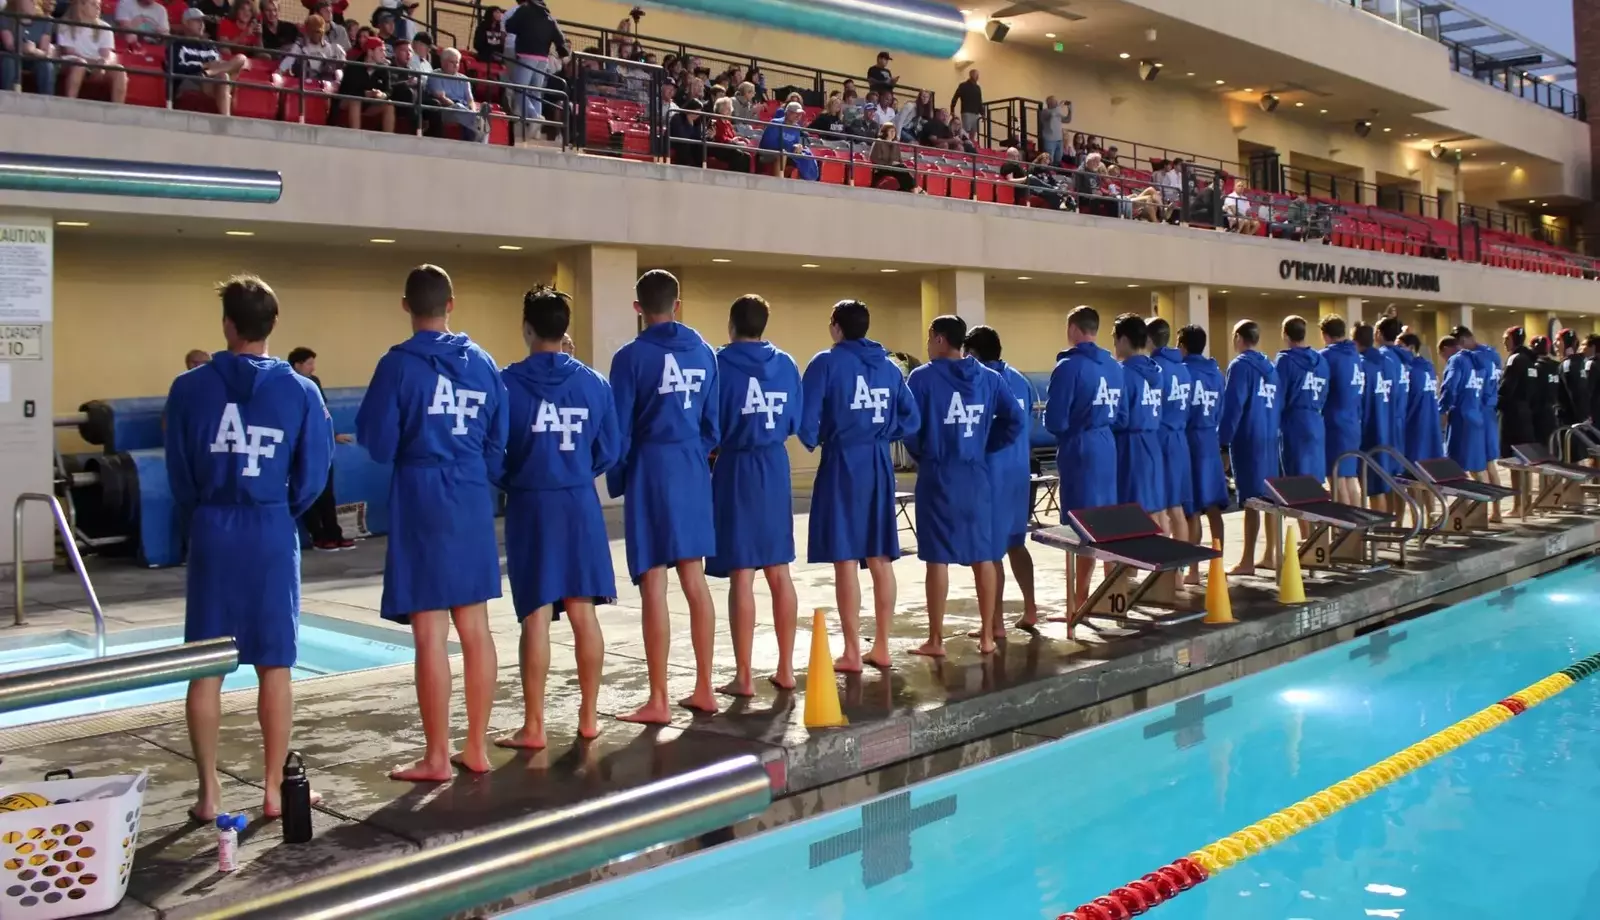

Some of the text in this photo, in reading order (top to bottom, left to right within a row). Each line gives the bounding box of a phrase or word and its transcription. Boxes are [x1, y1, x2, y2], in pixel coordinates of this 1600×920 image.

[0, 228, 46, 243] AUTION
[1339, 265, 1395, 288] AQUATICS
[8, 341, 24, 356] 10
[658, 353, 705, 409] AF
[1092, 376, 1121, 418] AF
[1141, 379, 1161, 416] AF
[1167, 374, 1190, 410] AF
[1191, 379, 1218, 416] AF
[1257, 376, 1276, 408] AF
[1302, 371, 1325, 400] AF
[1374, 371, 1392, 402] AF
[1465, 369, 1484, 397] AF
[428, 374, 486, 435] AF
[741, 377, 787, 429] AF
[850, 375, 890, 423] AF
[944, 391, 984, 437] AF
[210, 402, 284, 476] AF
[531, 399, 589, 450] AF
[1553, 493, 1561, 505] 7
[1453, 517, 1462, 531] 8
[1315, 546, 1325, 564] 9
[1108, 593, 1126, 613] 10
